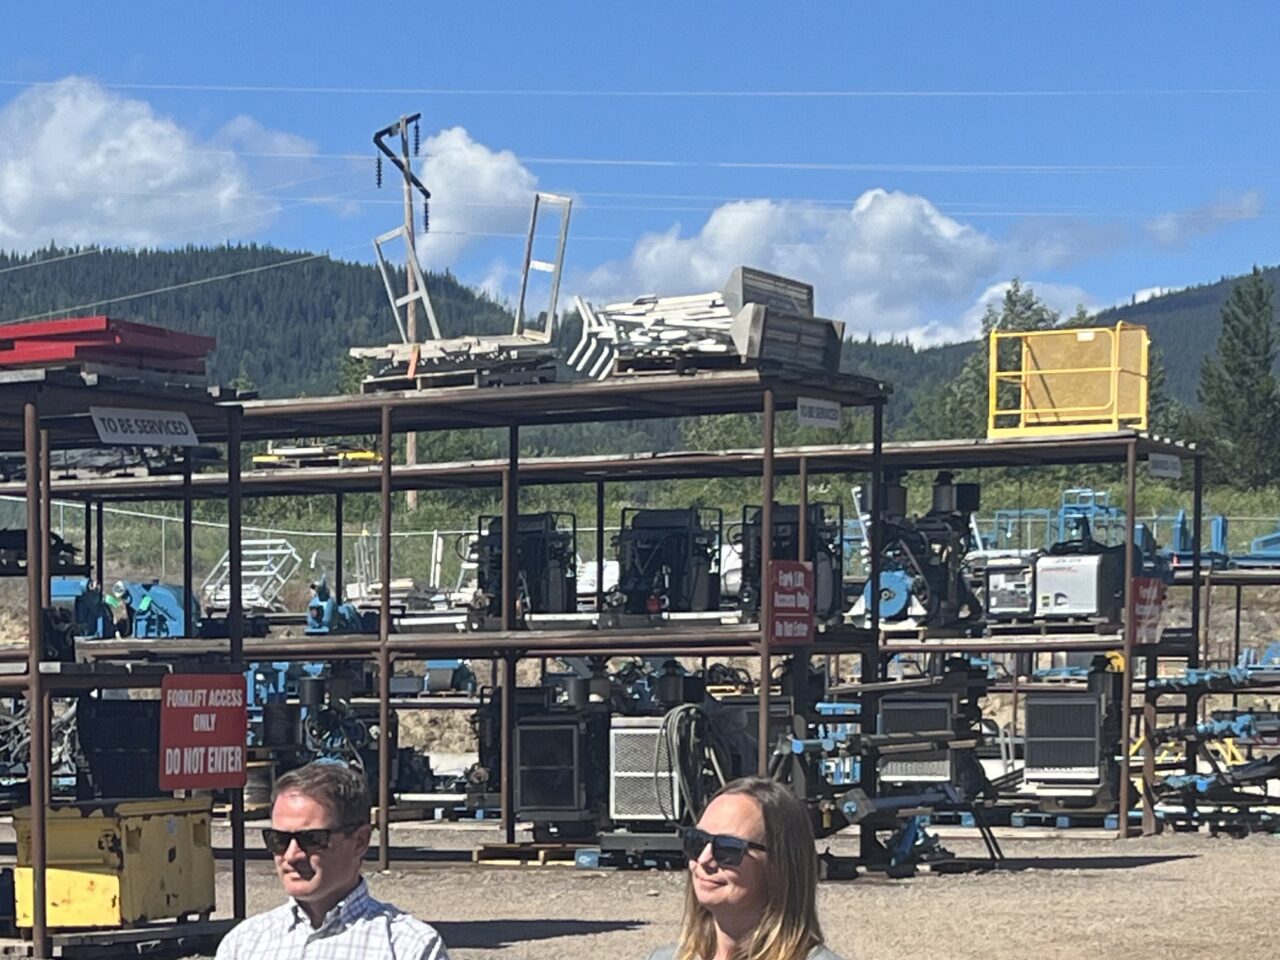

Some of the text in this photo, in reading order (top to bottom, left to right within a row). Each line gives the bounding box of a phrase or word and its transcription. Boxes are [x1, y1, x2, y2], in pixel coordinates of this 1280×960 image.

[98, 417, 189, 436] TO BE SERVICED
[166, 688, 243, 708] FORKLIFT ACCESS
[193, 713, 217, 732] ONLY
[165, 746, 242, 775] DO NOT ENTER
